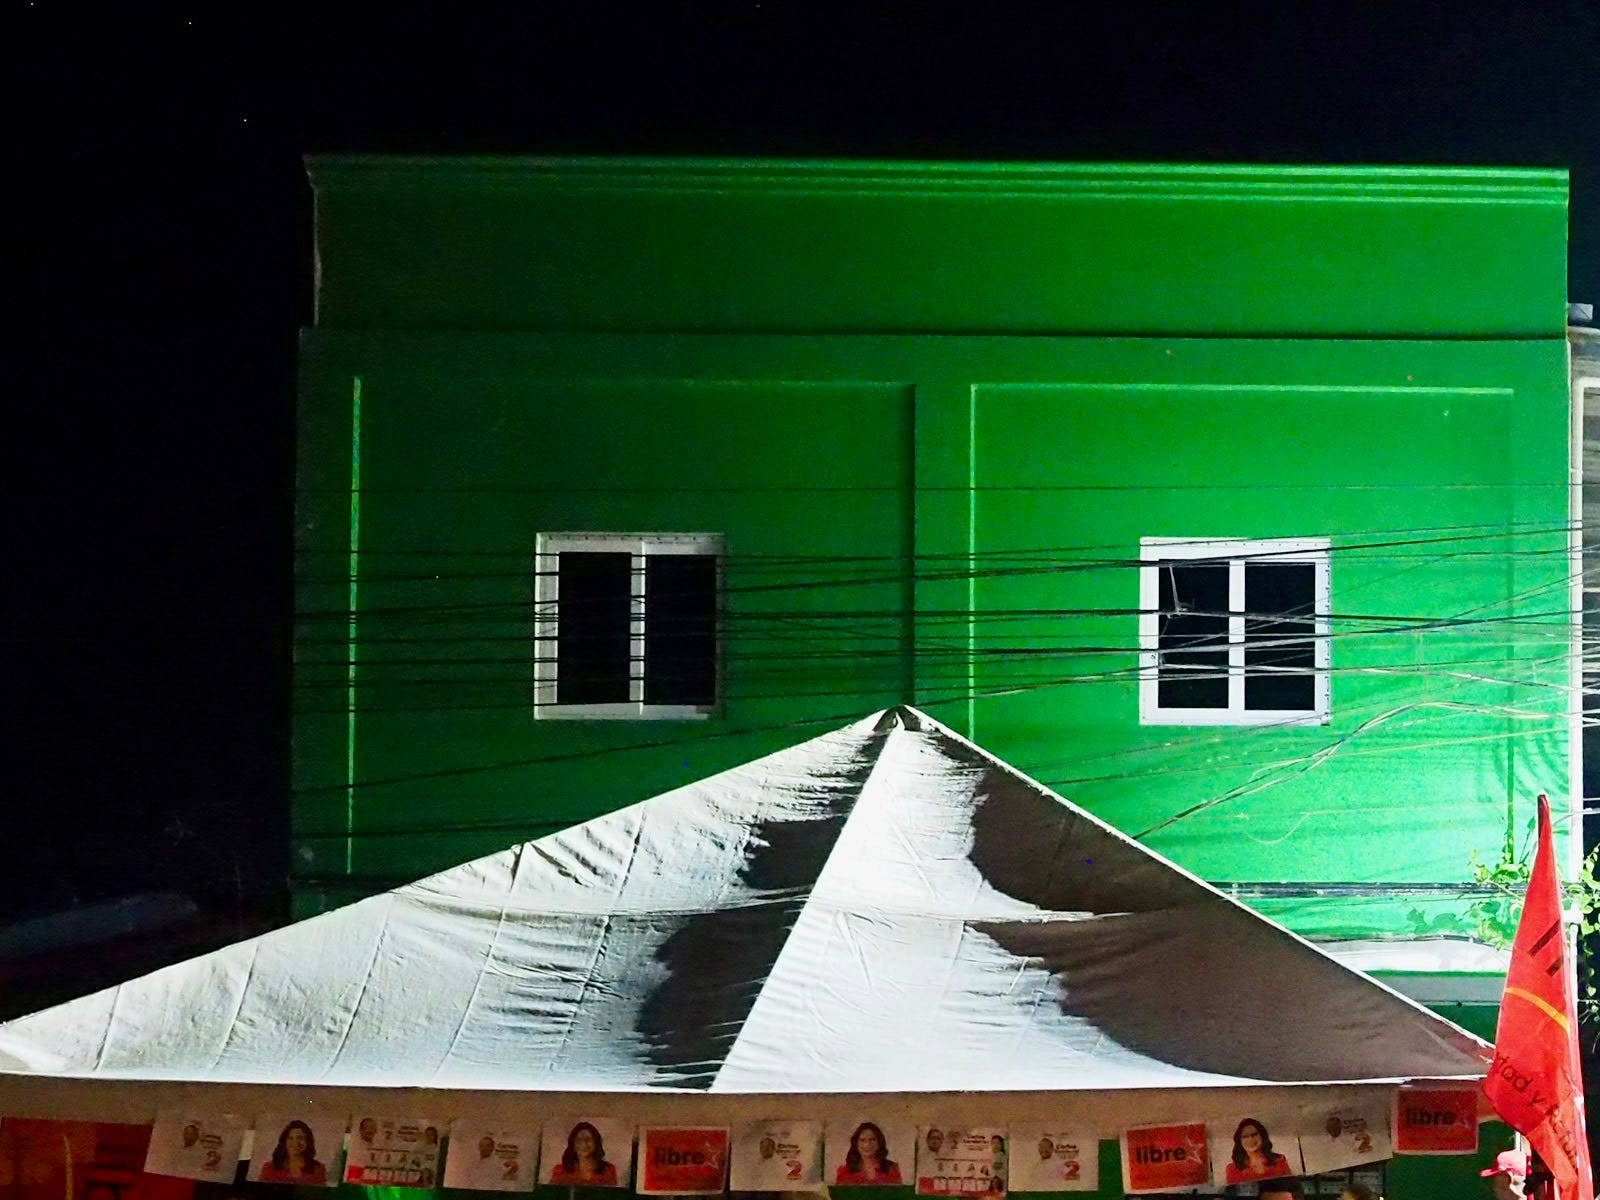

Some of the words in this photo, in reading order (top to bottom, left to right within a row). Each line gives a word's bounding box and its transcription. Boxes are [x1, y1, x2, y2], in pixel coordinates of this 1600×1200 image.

[1496, 1051, 1534, 1093] tad
[1406, 1108, 1457, 1125] libre
[1355, 1133, 1373, 1153] 2
[654, 1146, 705, 1166] libre
[1136, 1145, 1187, 1164] libre
[503, 1161, 519, 1180] 2
[786, 1160, 802, 1180] 2
[1064, 1161, 1080, 1180] 2
